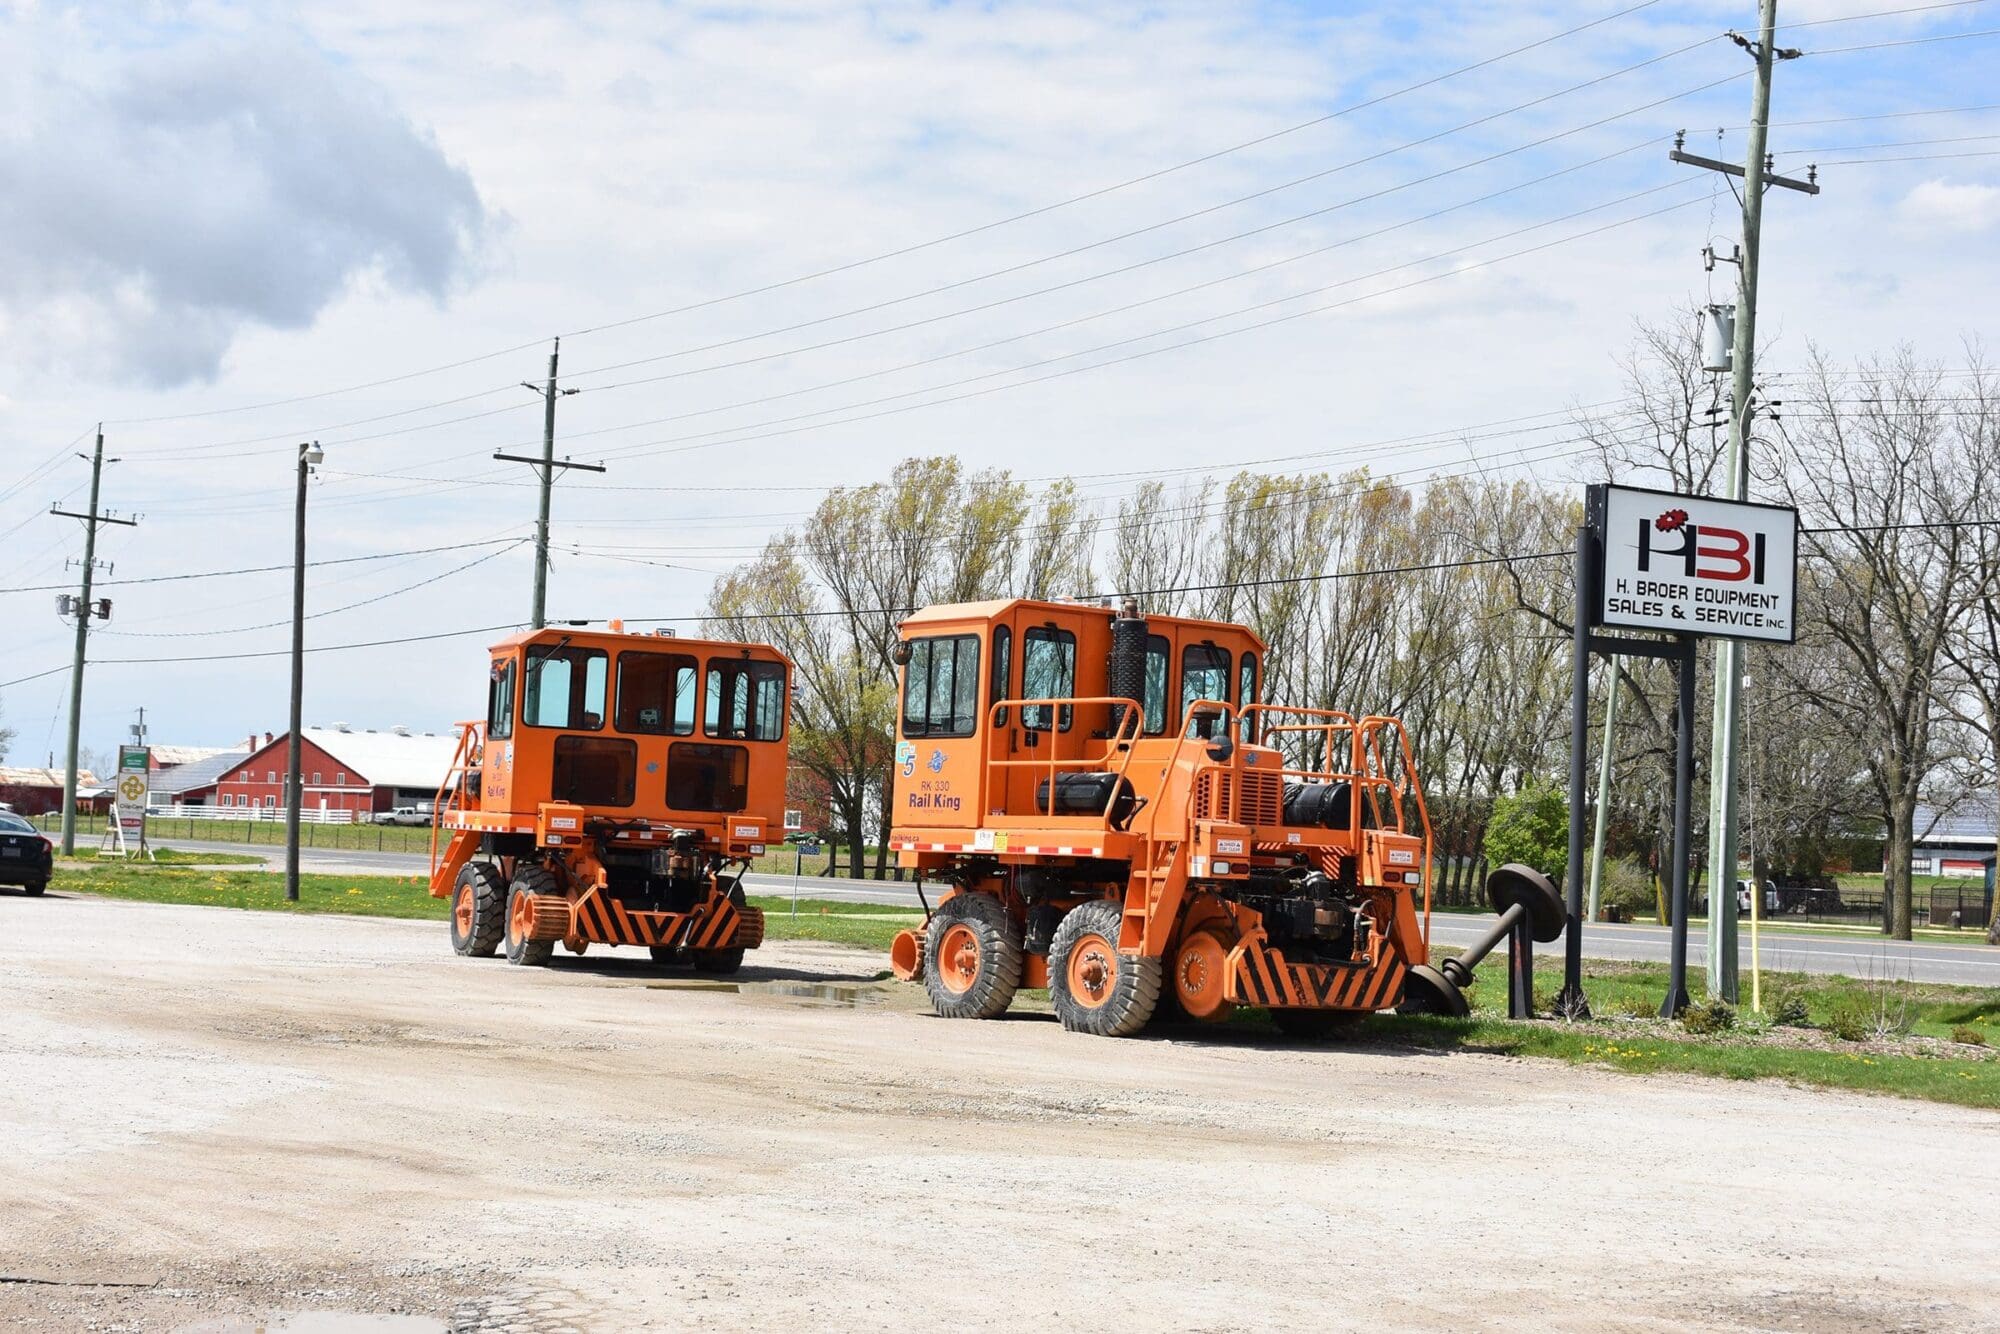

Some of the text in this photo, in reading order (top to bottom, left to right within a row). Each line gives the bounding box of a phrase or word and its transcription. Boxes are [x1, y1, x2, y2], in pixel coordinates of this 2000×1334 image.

[1637, 517, 1766, 585] HBI
[1616, 578, 1779, 610] H. BROER EQUIPMENT
[1608, 598, 1787, 629] SALES & SERVICE INC.
[921, 780, 950, 792] RK 330
[908, 793, 961, 811] Rail King
